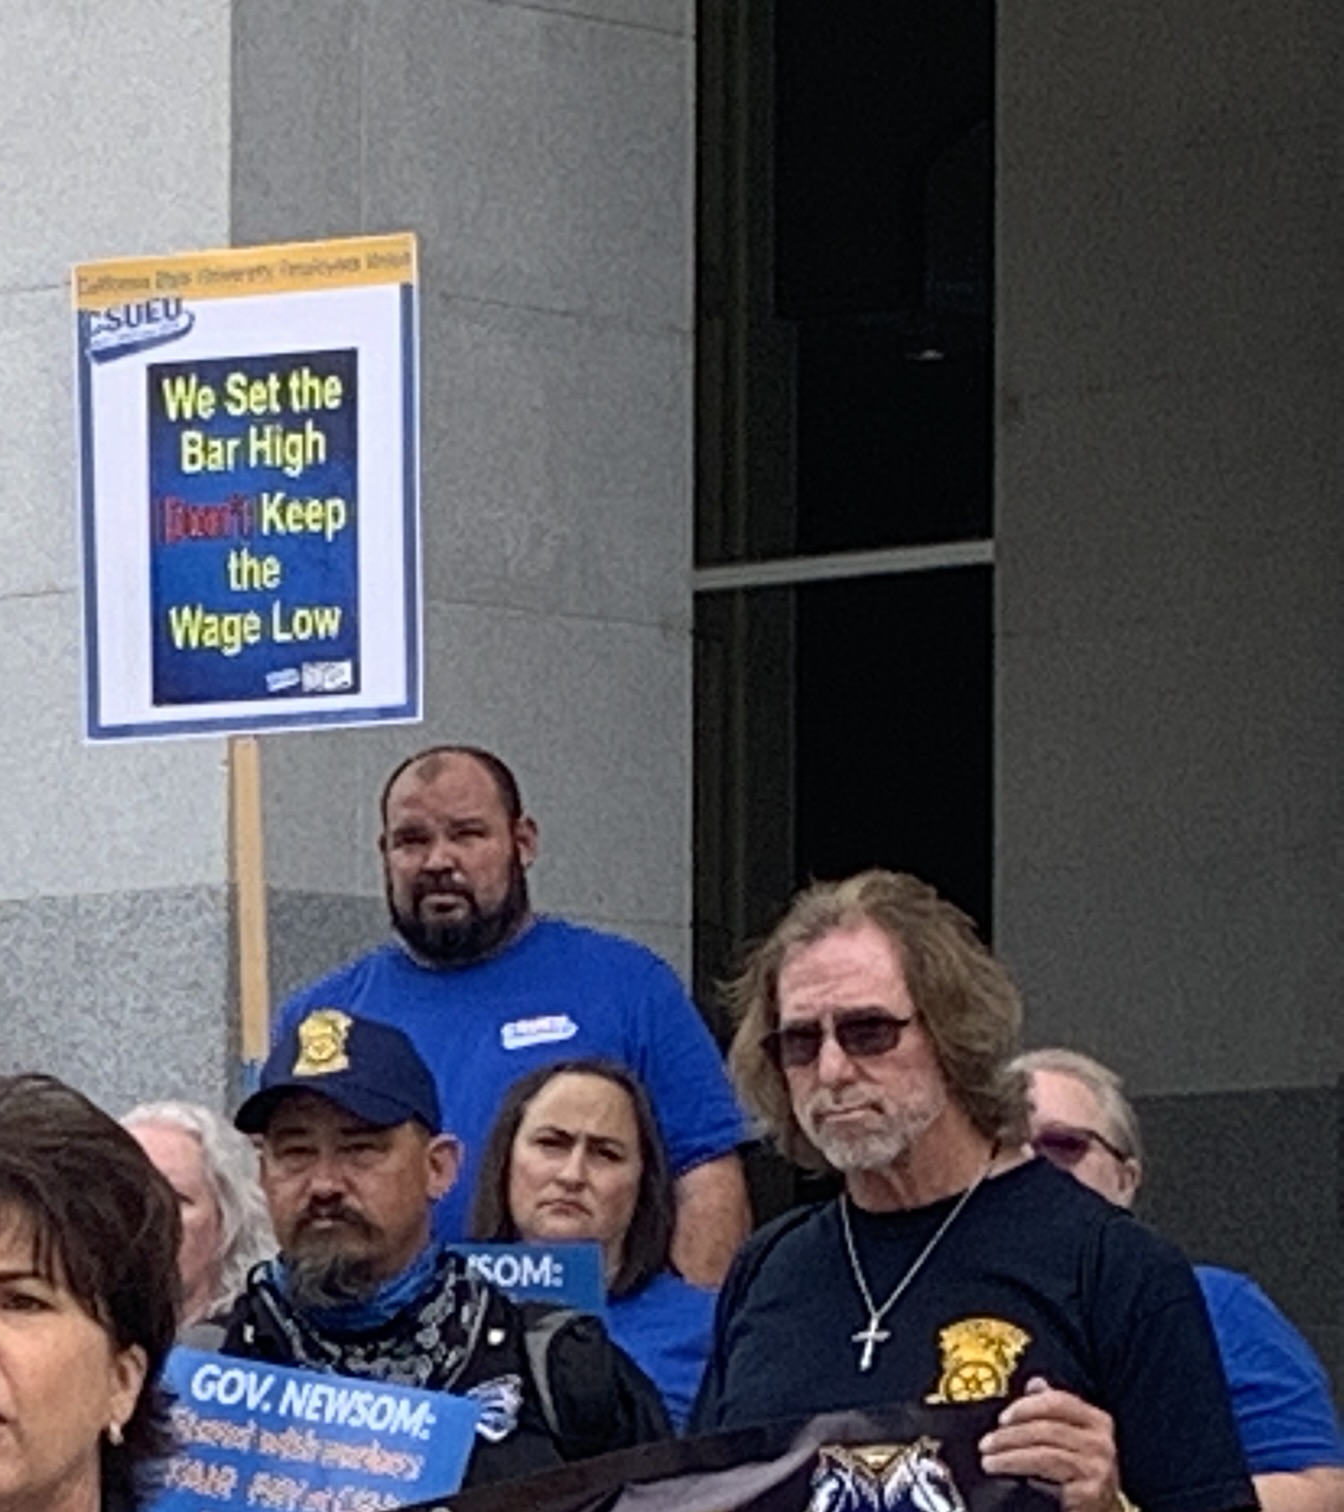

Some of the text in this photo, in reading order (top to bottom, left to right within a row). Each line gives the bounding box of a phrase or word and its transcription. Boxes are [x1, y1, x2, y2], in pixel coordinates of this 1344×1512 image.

[162, 366, 343, 422] We Set the
[181, 420, 326, 478] Bar High
[261, 491, 346, 543] Keep
[229, 548, 281, 593] the
[169, 600, 341, 656] Wage Low
[191, 1363, 437, 1441] GOV. NEWSOM:
